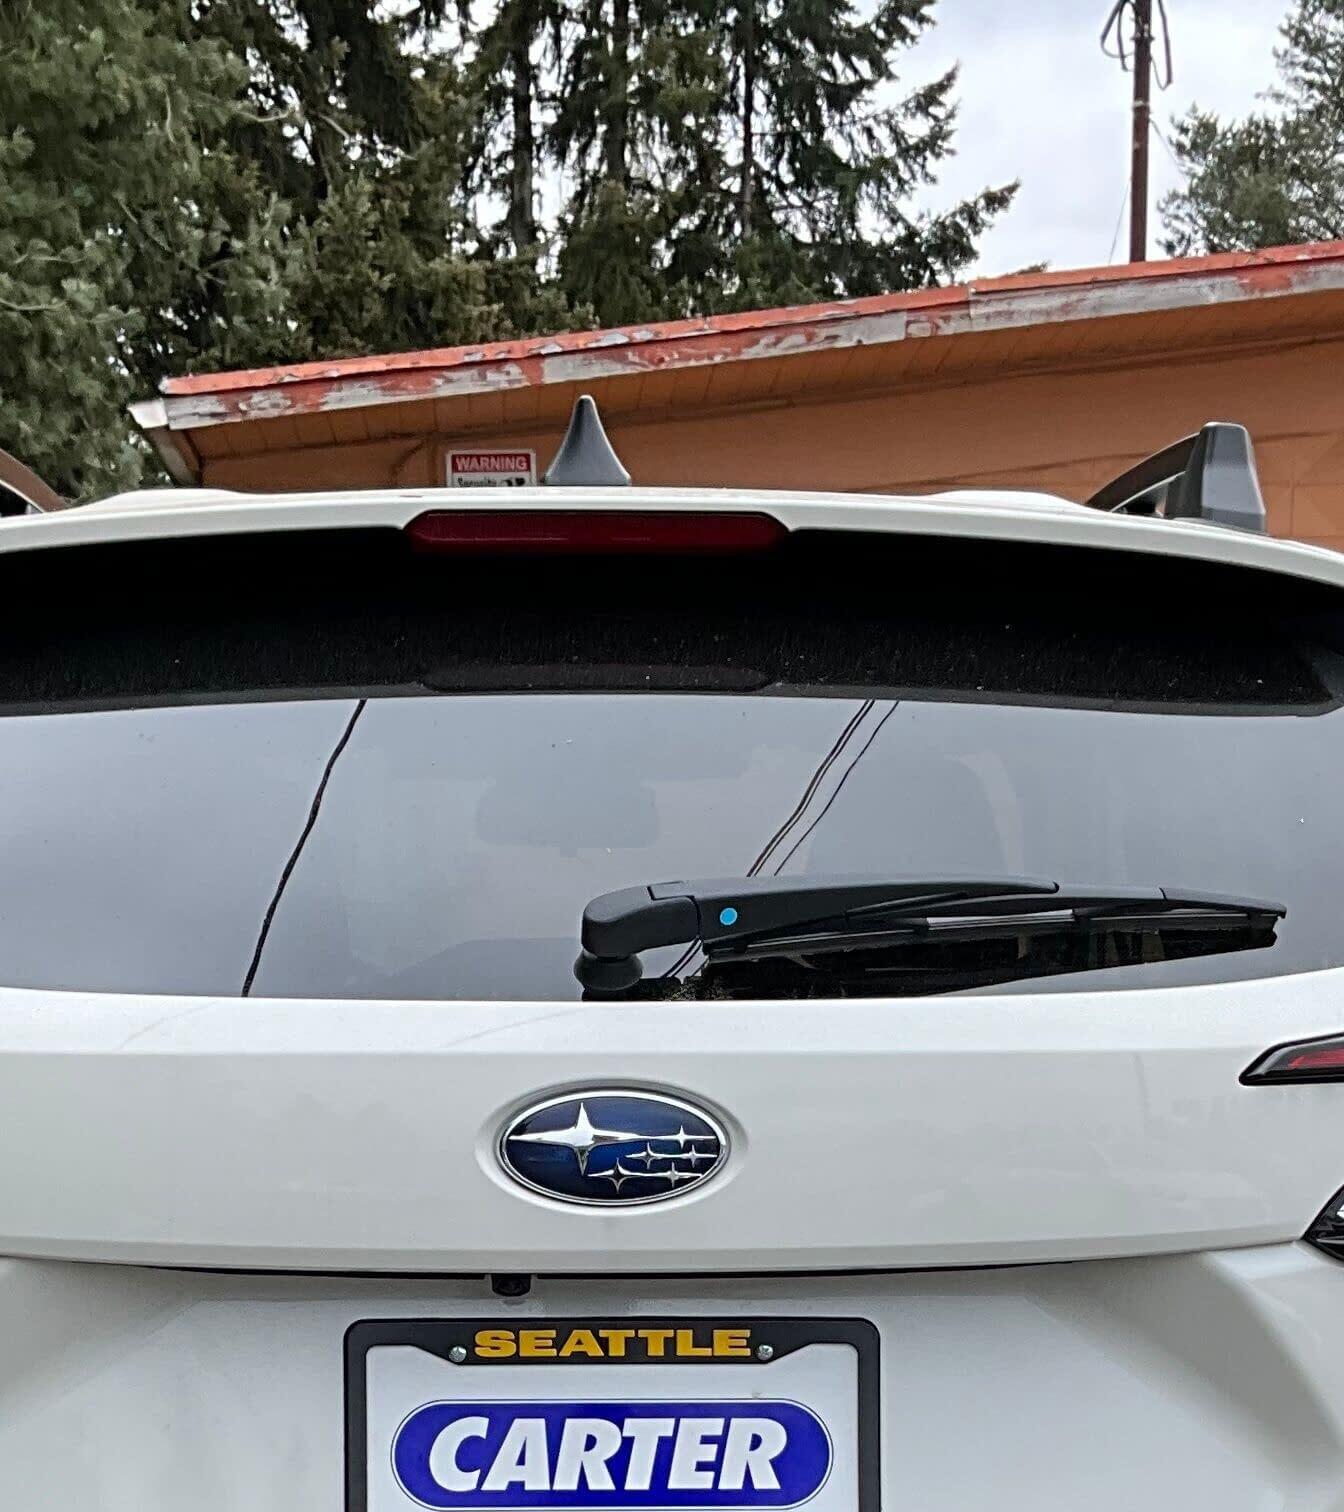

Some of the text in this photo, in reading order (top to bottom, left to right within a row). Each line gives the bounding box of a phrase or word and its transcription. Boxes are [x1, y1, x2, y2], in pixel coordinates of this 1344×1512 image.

[455, 454, 528, 472] WARNING
[473, 1329, 752, 1358] SEATTLE
[428, 1416, 788, 1492] CARTER
